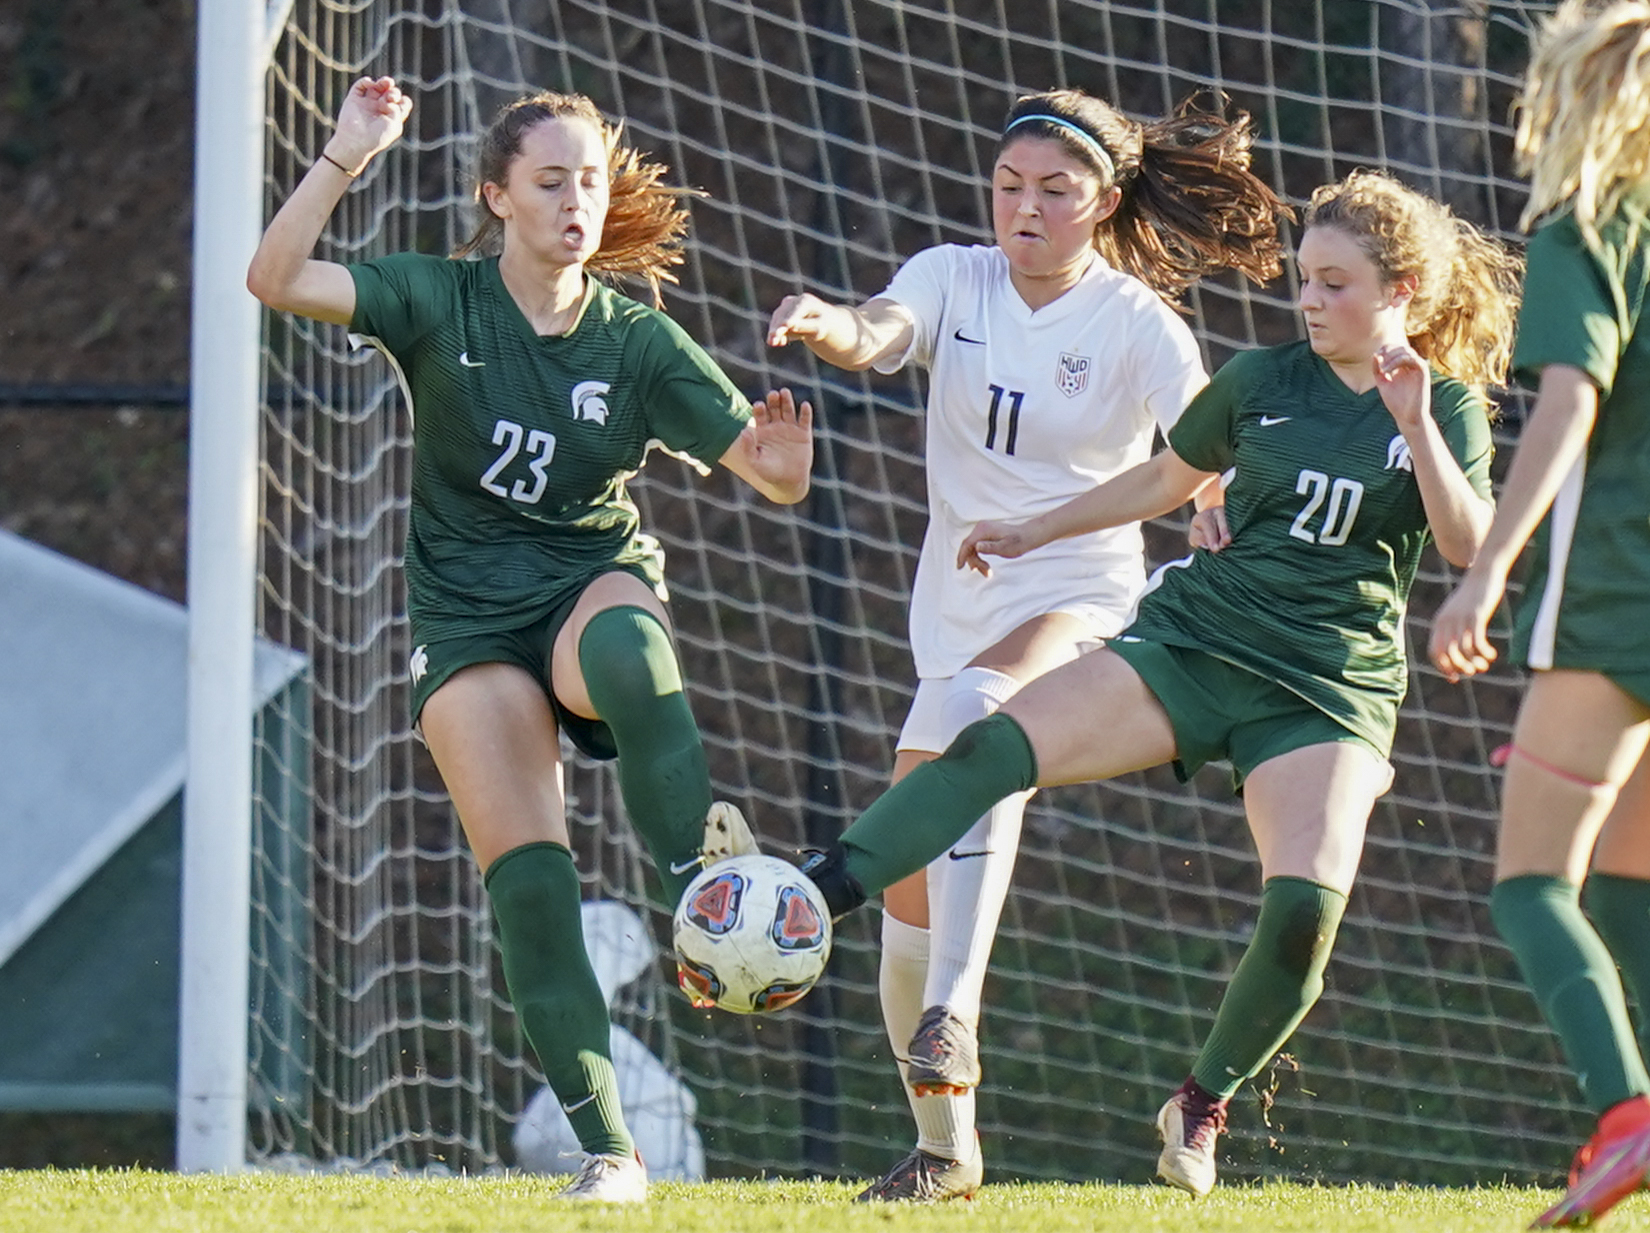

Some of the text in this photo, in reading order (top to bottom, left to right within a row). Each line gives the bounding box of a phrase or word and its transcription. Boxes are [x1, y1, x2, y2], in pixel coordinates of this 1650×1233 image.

[985, 383, 1025, 456] 11
[480, 419, 556, 504] 23
[1289, 468, 1364, 546] 20
